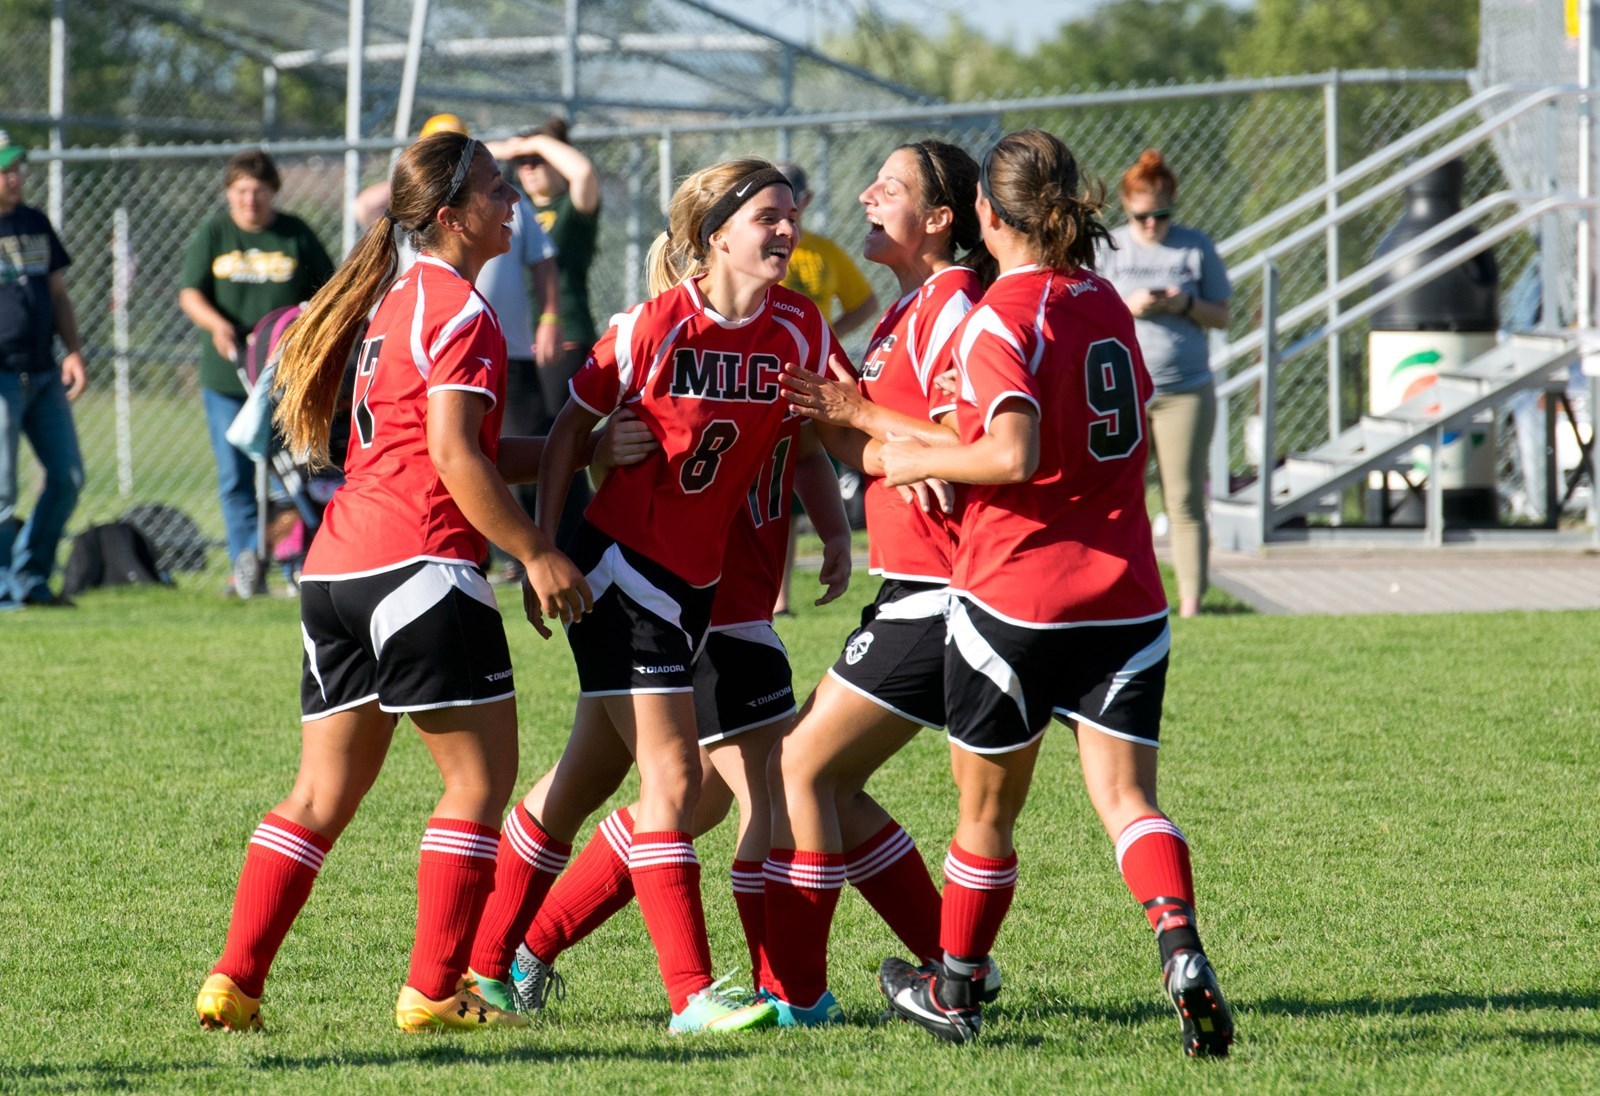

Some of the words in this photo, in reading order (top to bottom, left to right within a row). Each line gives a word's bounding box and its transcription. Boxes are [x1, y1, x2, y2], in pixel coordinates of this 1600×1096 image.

[773, 300, 805, 319] IADORA
[669, 348, 781, 405] MLC
[1085, 337, 1143, 462] 9
[679, 419, 740, 495] 8
[646, 664, 685, 674] DIADORA
